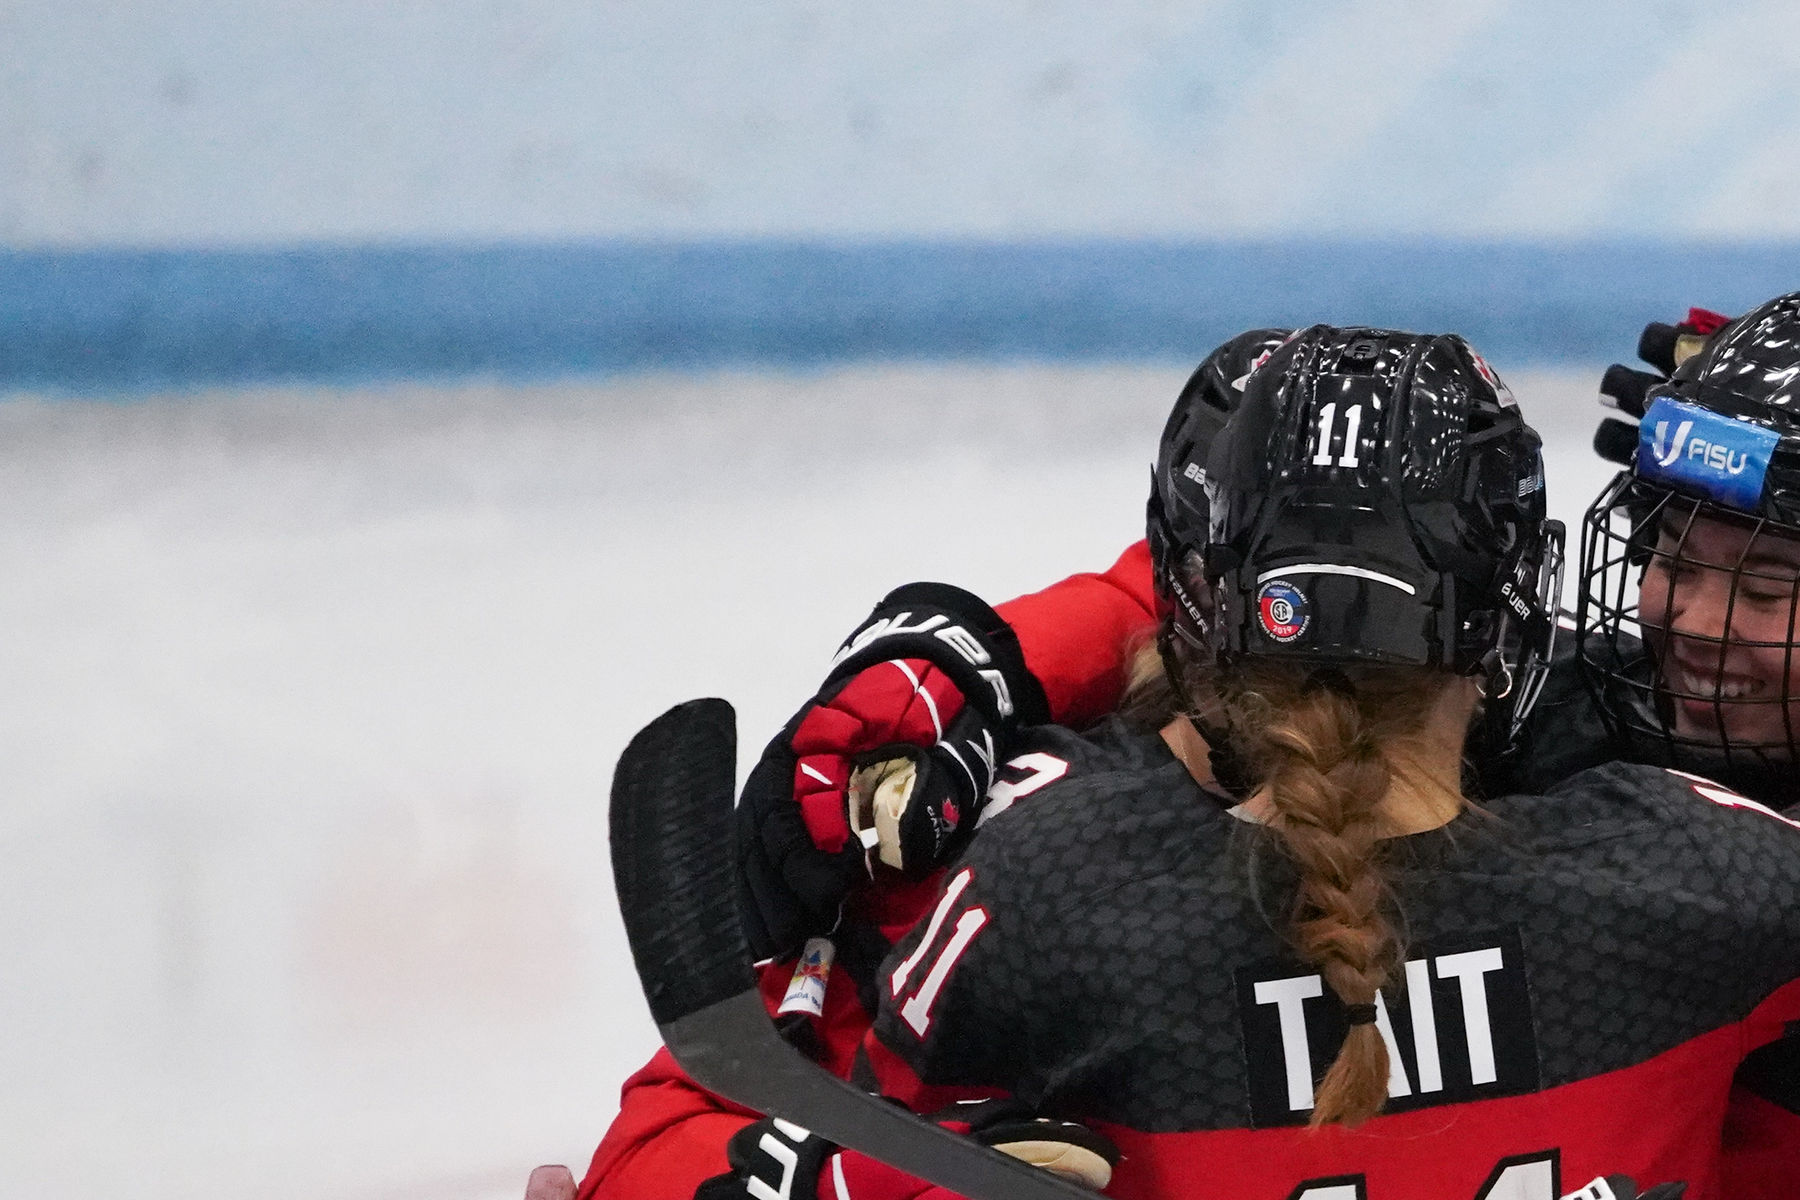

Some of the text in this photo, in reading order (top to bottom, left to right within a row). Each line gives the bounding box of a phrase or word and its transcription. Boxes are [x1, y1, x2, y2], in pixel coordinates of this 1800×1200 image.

[1312, 402, 1362, 469] 11
[1688, 438, 1748, 475] FISU
[890, 867, 991, 1040] 11
